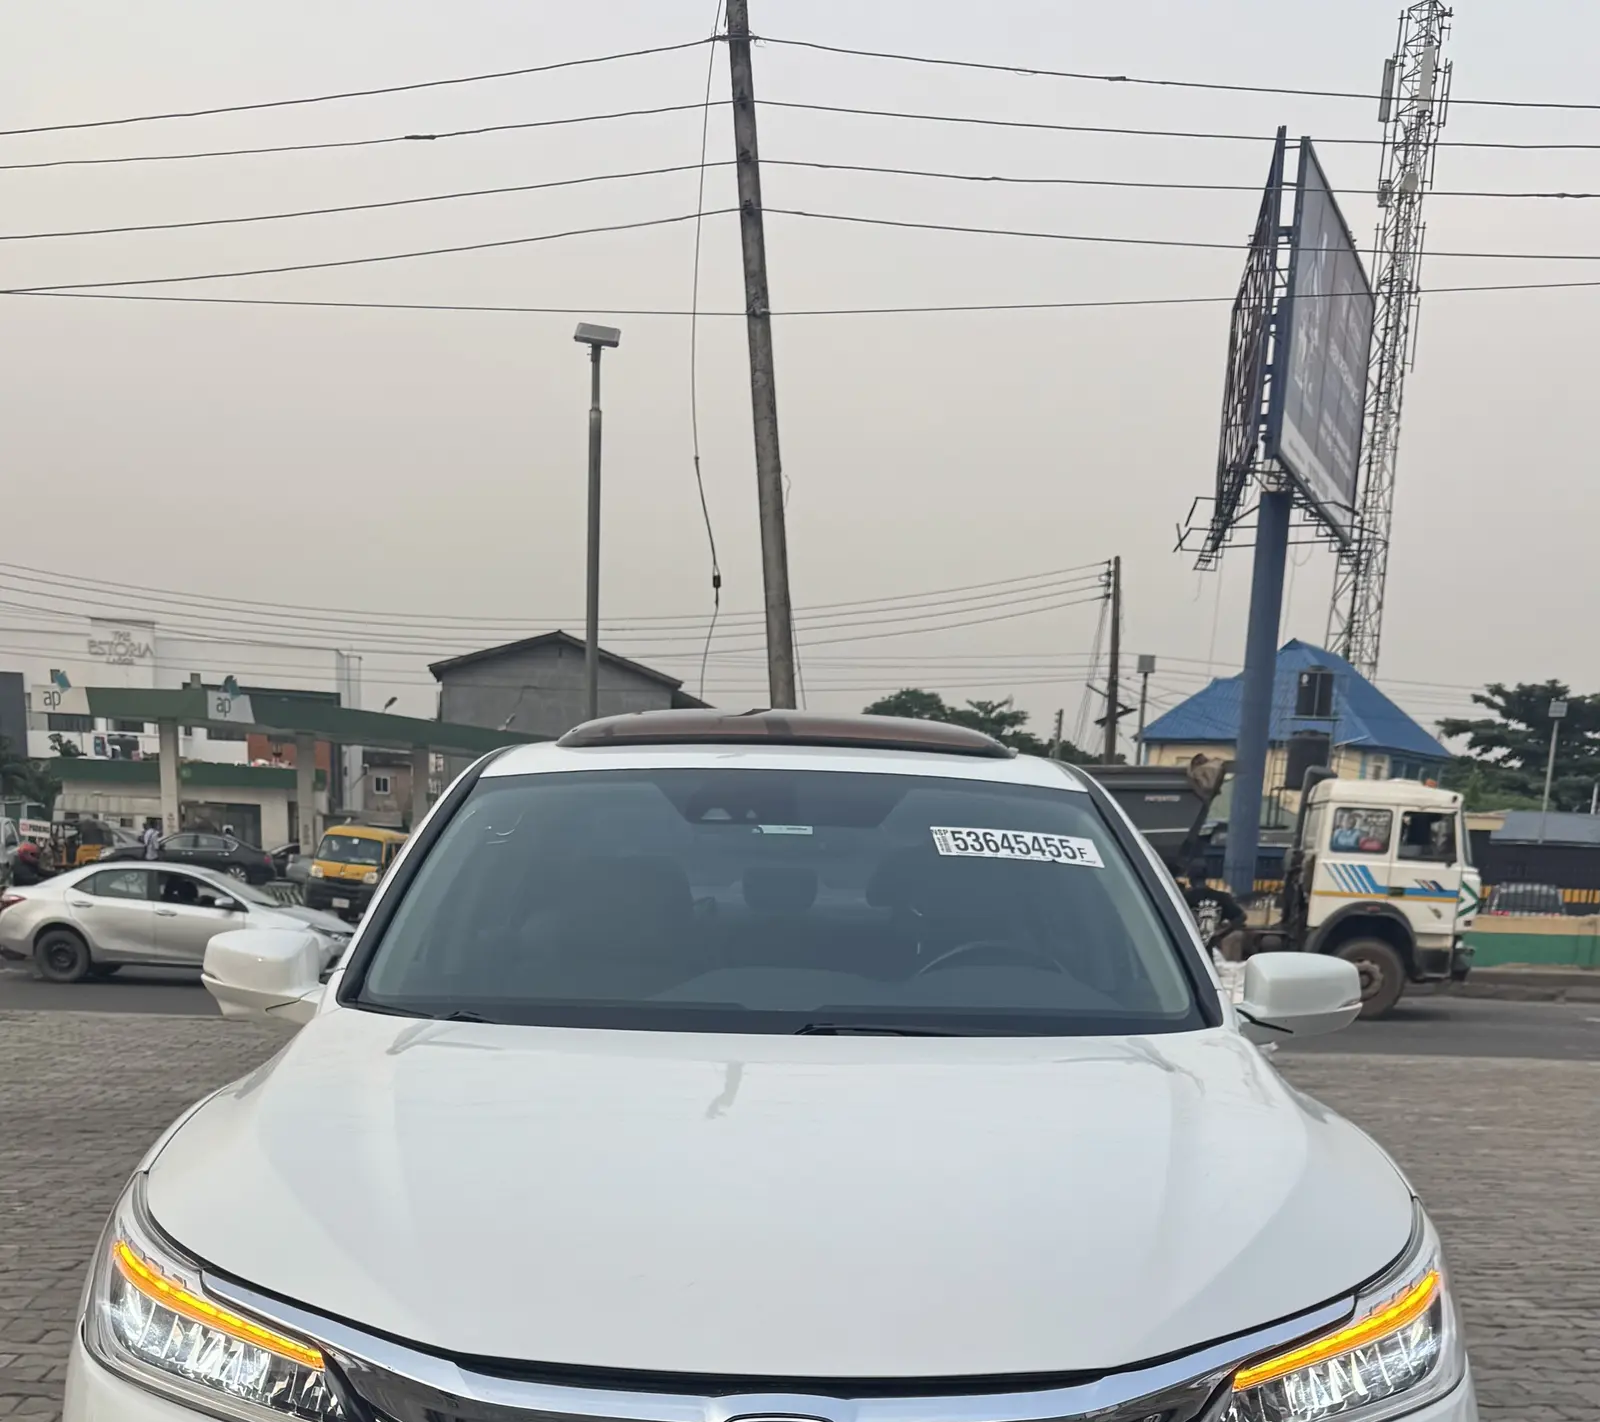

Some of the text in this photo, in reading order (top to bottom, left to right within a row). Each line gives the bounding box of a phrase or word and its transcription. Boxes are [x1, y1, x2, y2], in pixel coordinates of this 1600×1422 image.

[87, 639, 154, 658] ESTORIA
[43, 690, 61, 710] ap
[216, 697, 232, 717] ap
